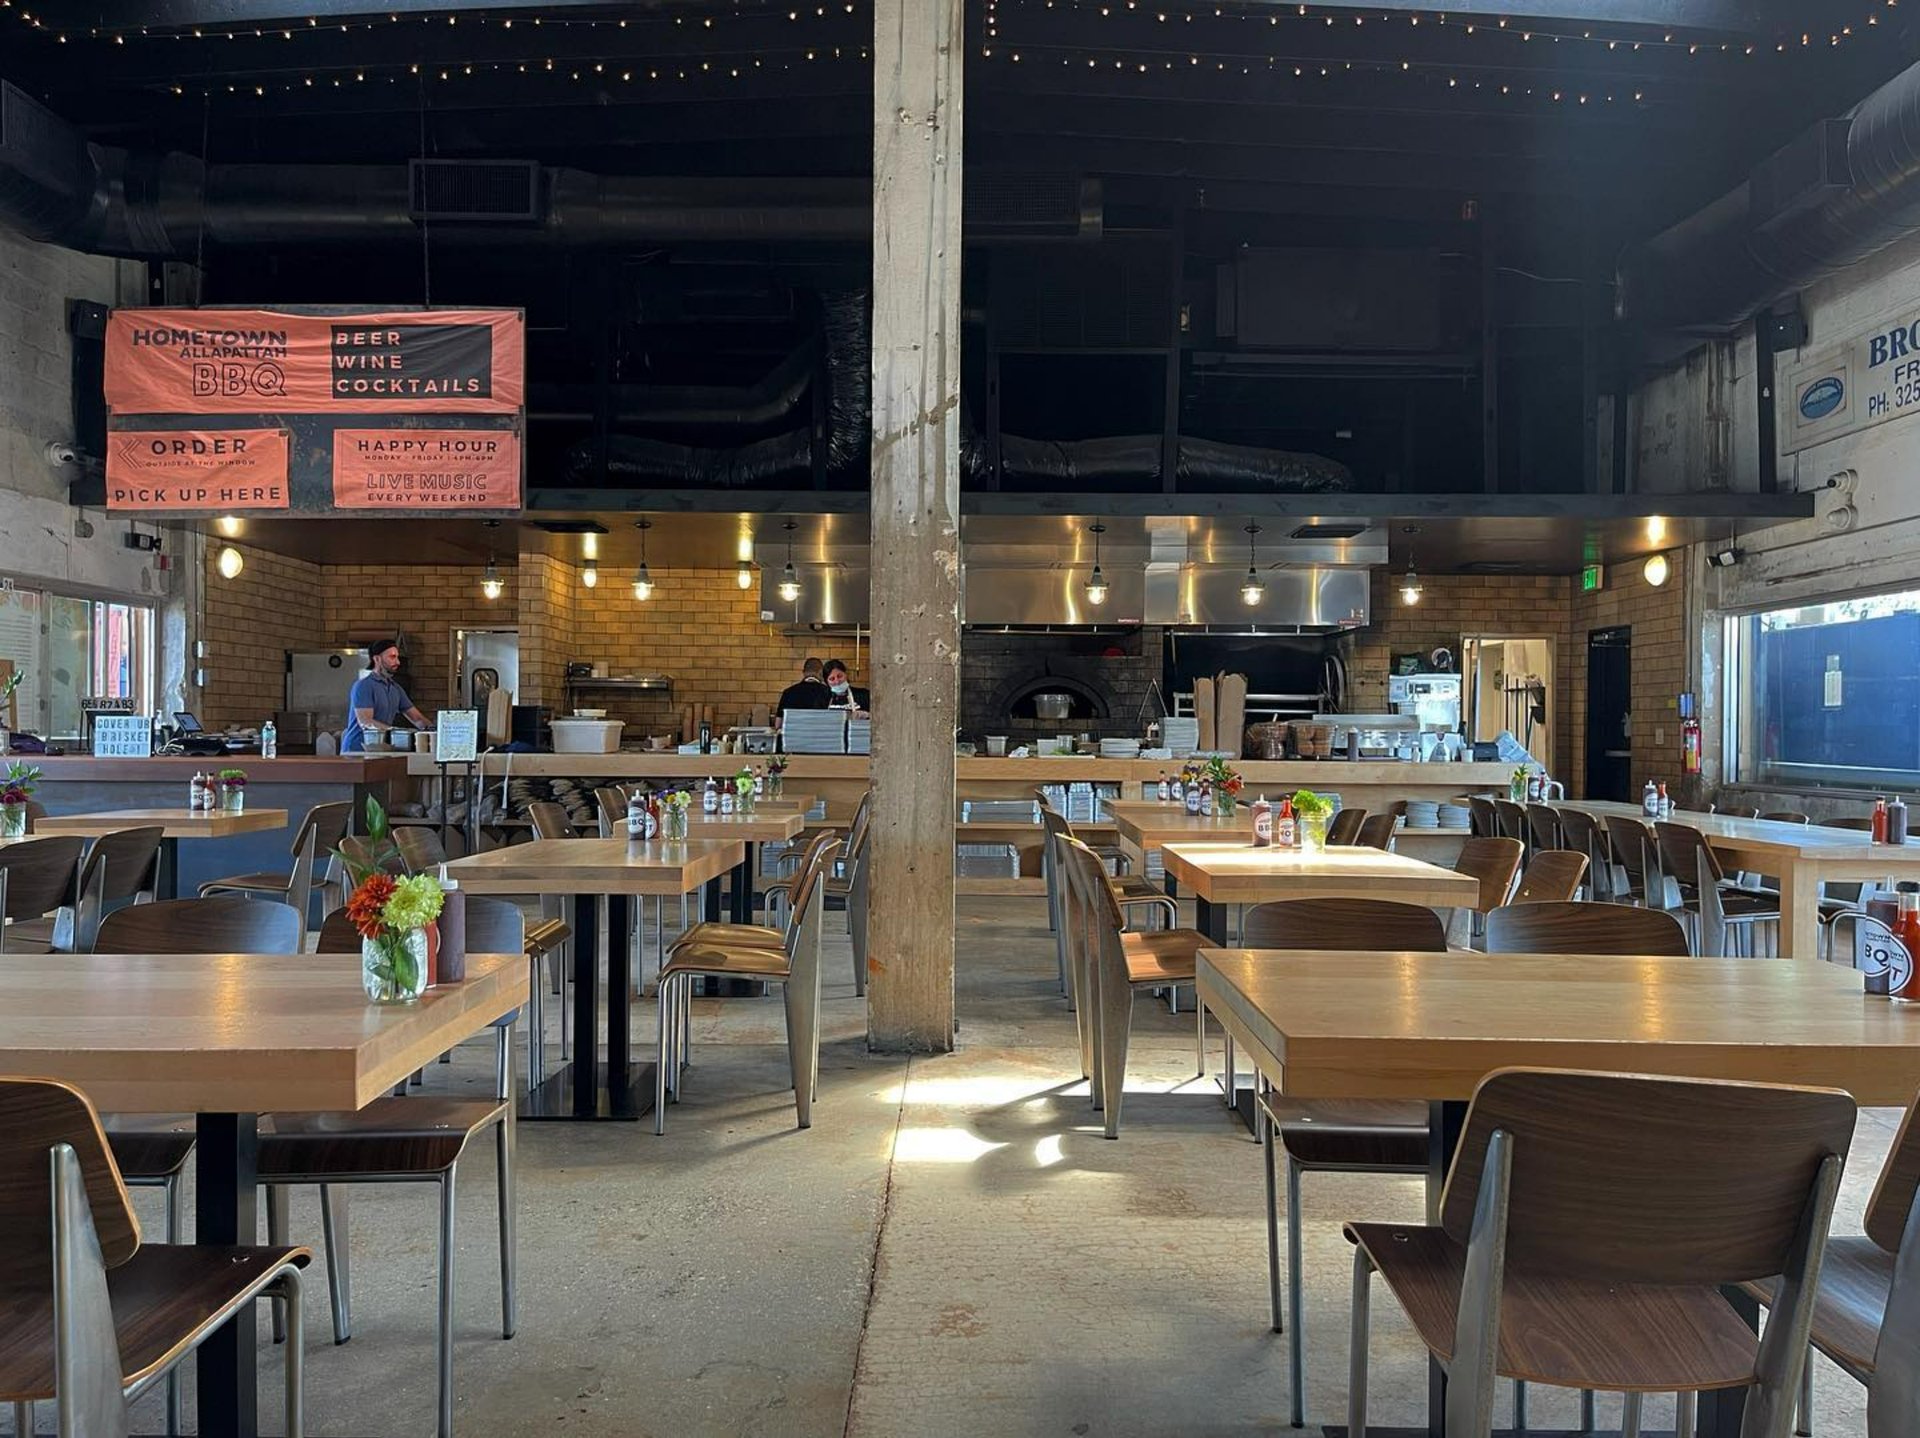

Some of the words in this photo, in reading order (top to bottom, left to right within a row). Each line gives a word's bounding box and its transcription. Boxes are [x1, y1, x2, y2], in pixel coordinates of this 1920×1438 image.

[133, 329, 287, 346] HOMETOWN
[335, 331, 401, 345] BEER
[180, 347, 287, 358] ALLAPATTAH
[336, 355, 402, 369] WINE
[193, 362, 288, 397] BBQ
[336, 378, 480, 393] COCKTAILS
[1869, 391, 1890, 418] PH:
[151, 438, 247, 455] ORDER
[358, 440, 428, 452] HAPPY
[439, 440, 497, 453] HOUR
[367, 474, 414, 489] LIVE
[419, 474, 487, 490] MUSIC
[115, 490, 167, 502] PICK
[179, 489, 207, 501] UP
[220, 487, 281, 501] HERE
[367, 493, 413, 502] EVERY
[420, 493, 487, 502] WEEKEND
[97, 719, 130, 729] COVER
[101, 732, 150, 742] BRISKET
[103, 744, 129, 755] HOLE
